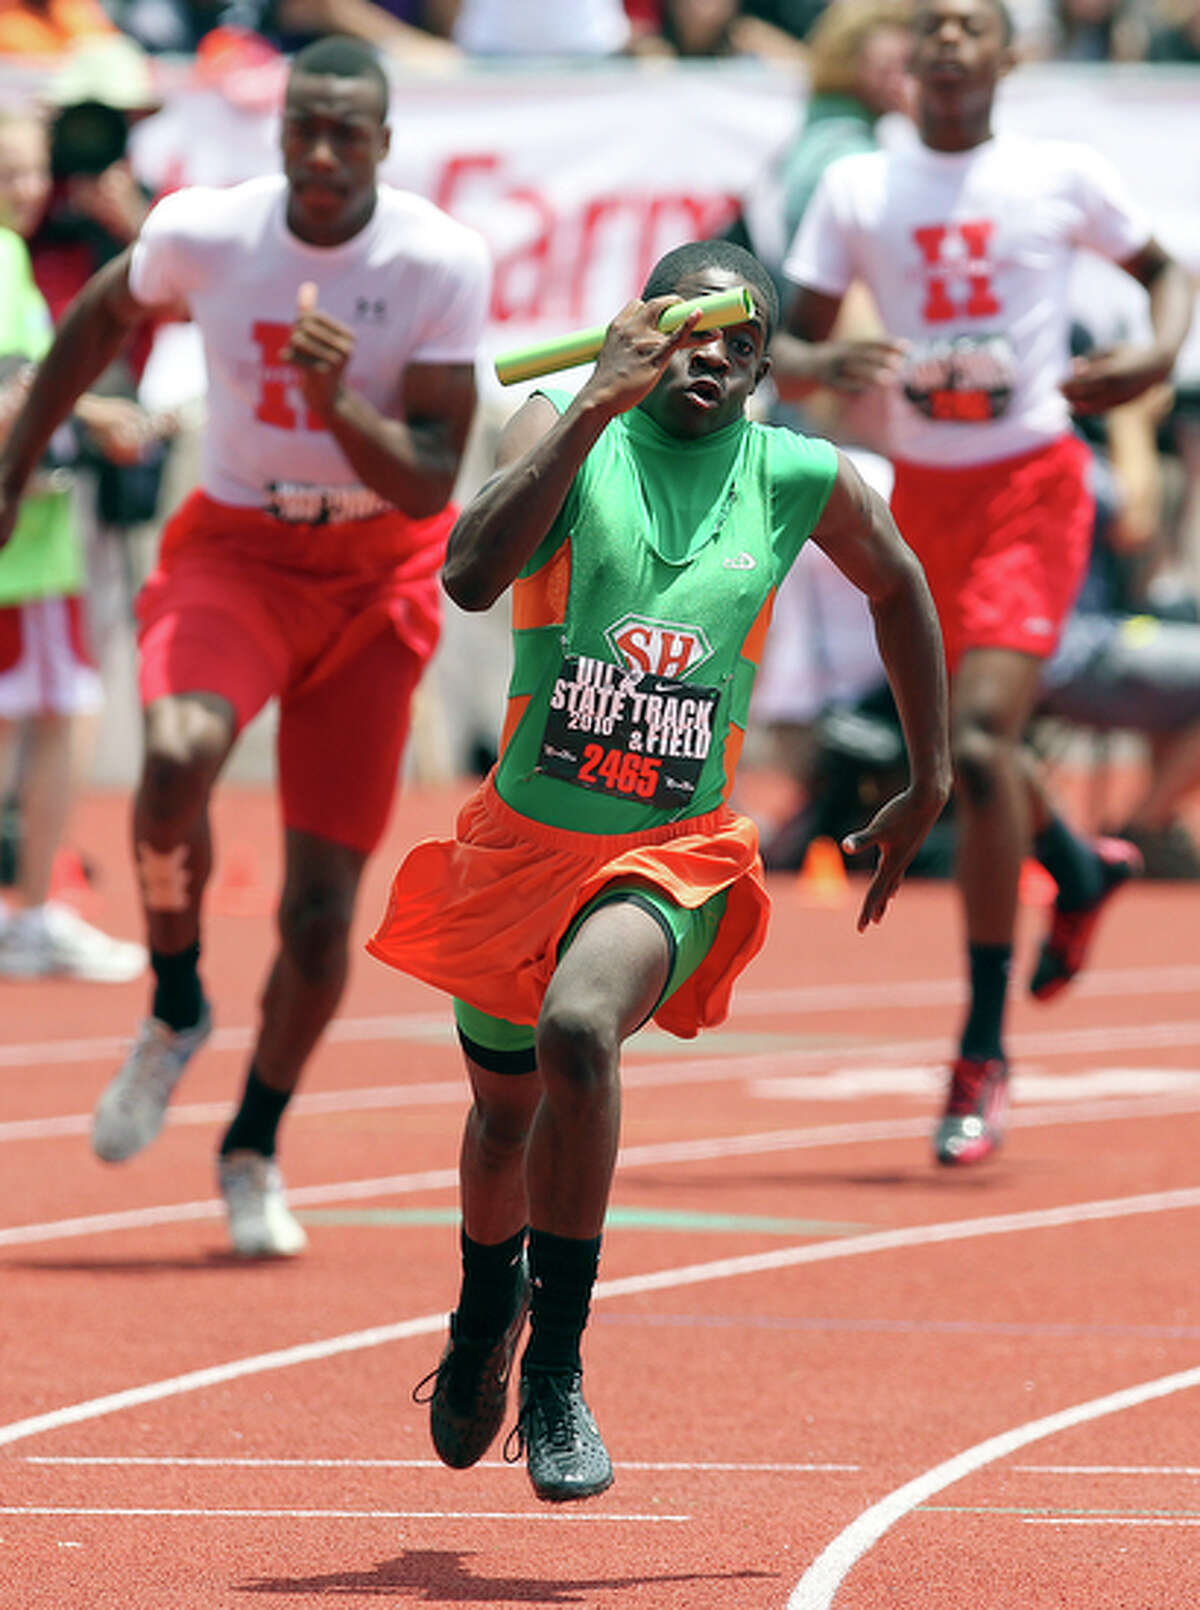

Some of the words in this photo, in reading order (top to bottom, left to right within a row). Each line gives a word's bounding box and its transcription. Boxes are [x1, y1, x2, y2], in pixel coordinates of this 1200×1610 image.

[616, 627, 695, 679] SH
[550, 678, 627, 721] STATE
[631, 691, 714, 732] TRACK
[567, 711, 615, 736] 2010
[628, 731, 644, 752] &
[645, 724, 713, 760] FIELD
[576, 743, 663, 798] 2465
